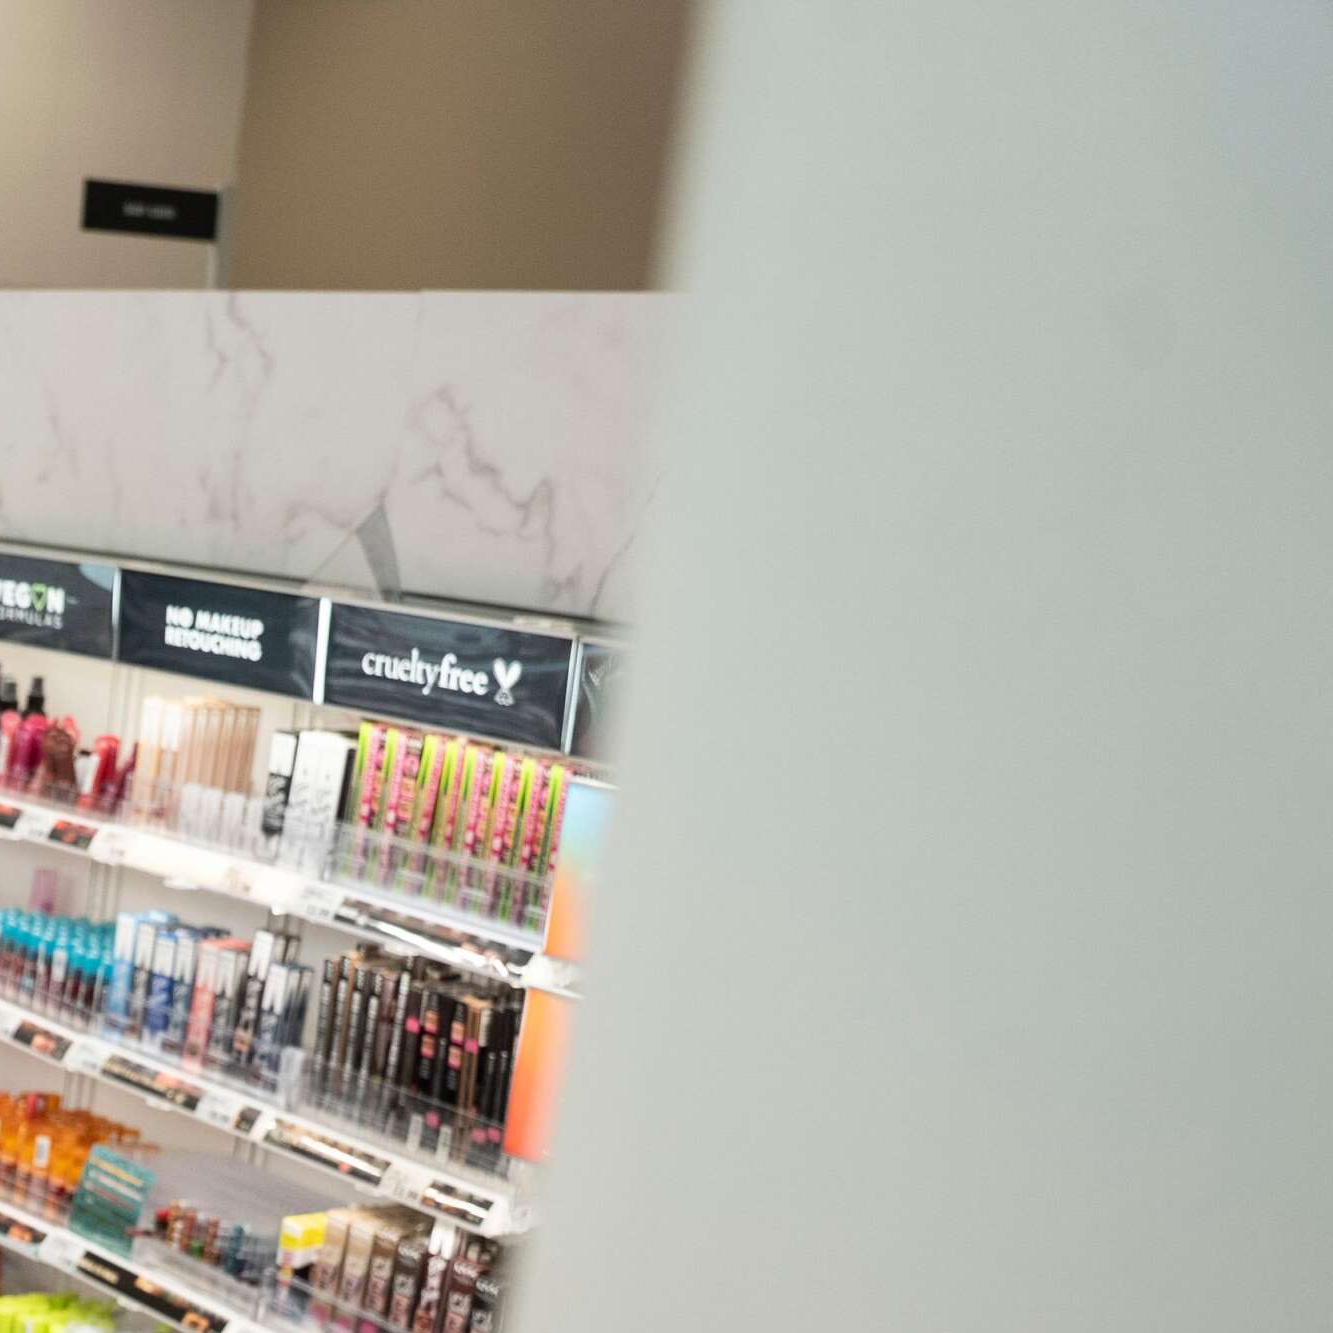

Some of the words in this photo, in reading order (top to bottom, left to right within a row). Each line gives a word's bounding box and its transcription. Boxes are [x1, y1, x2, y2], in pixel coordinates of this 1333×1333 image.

[165, 605, 194, 630] NO
[195, 608, 264, 641] MAKEUP
[164, 627, 262, 662] RETOUCHING
